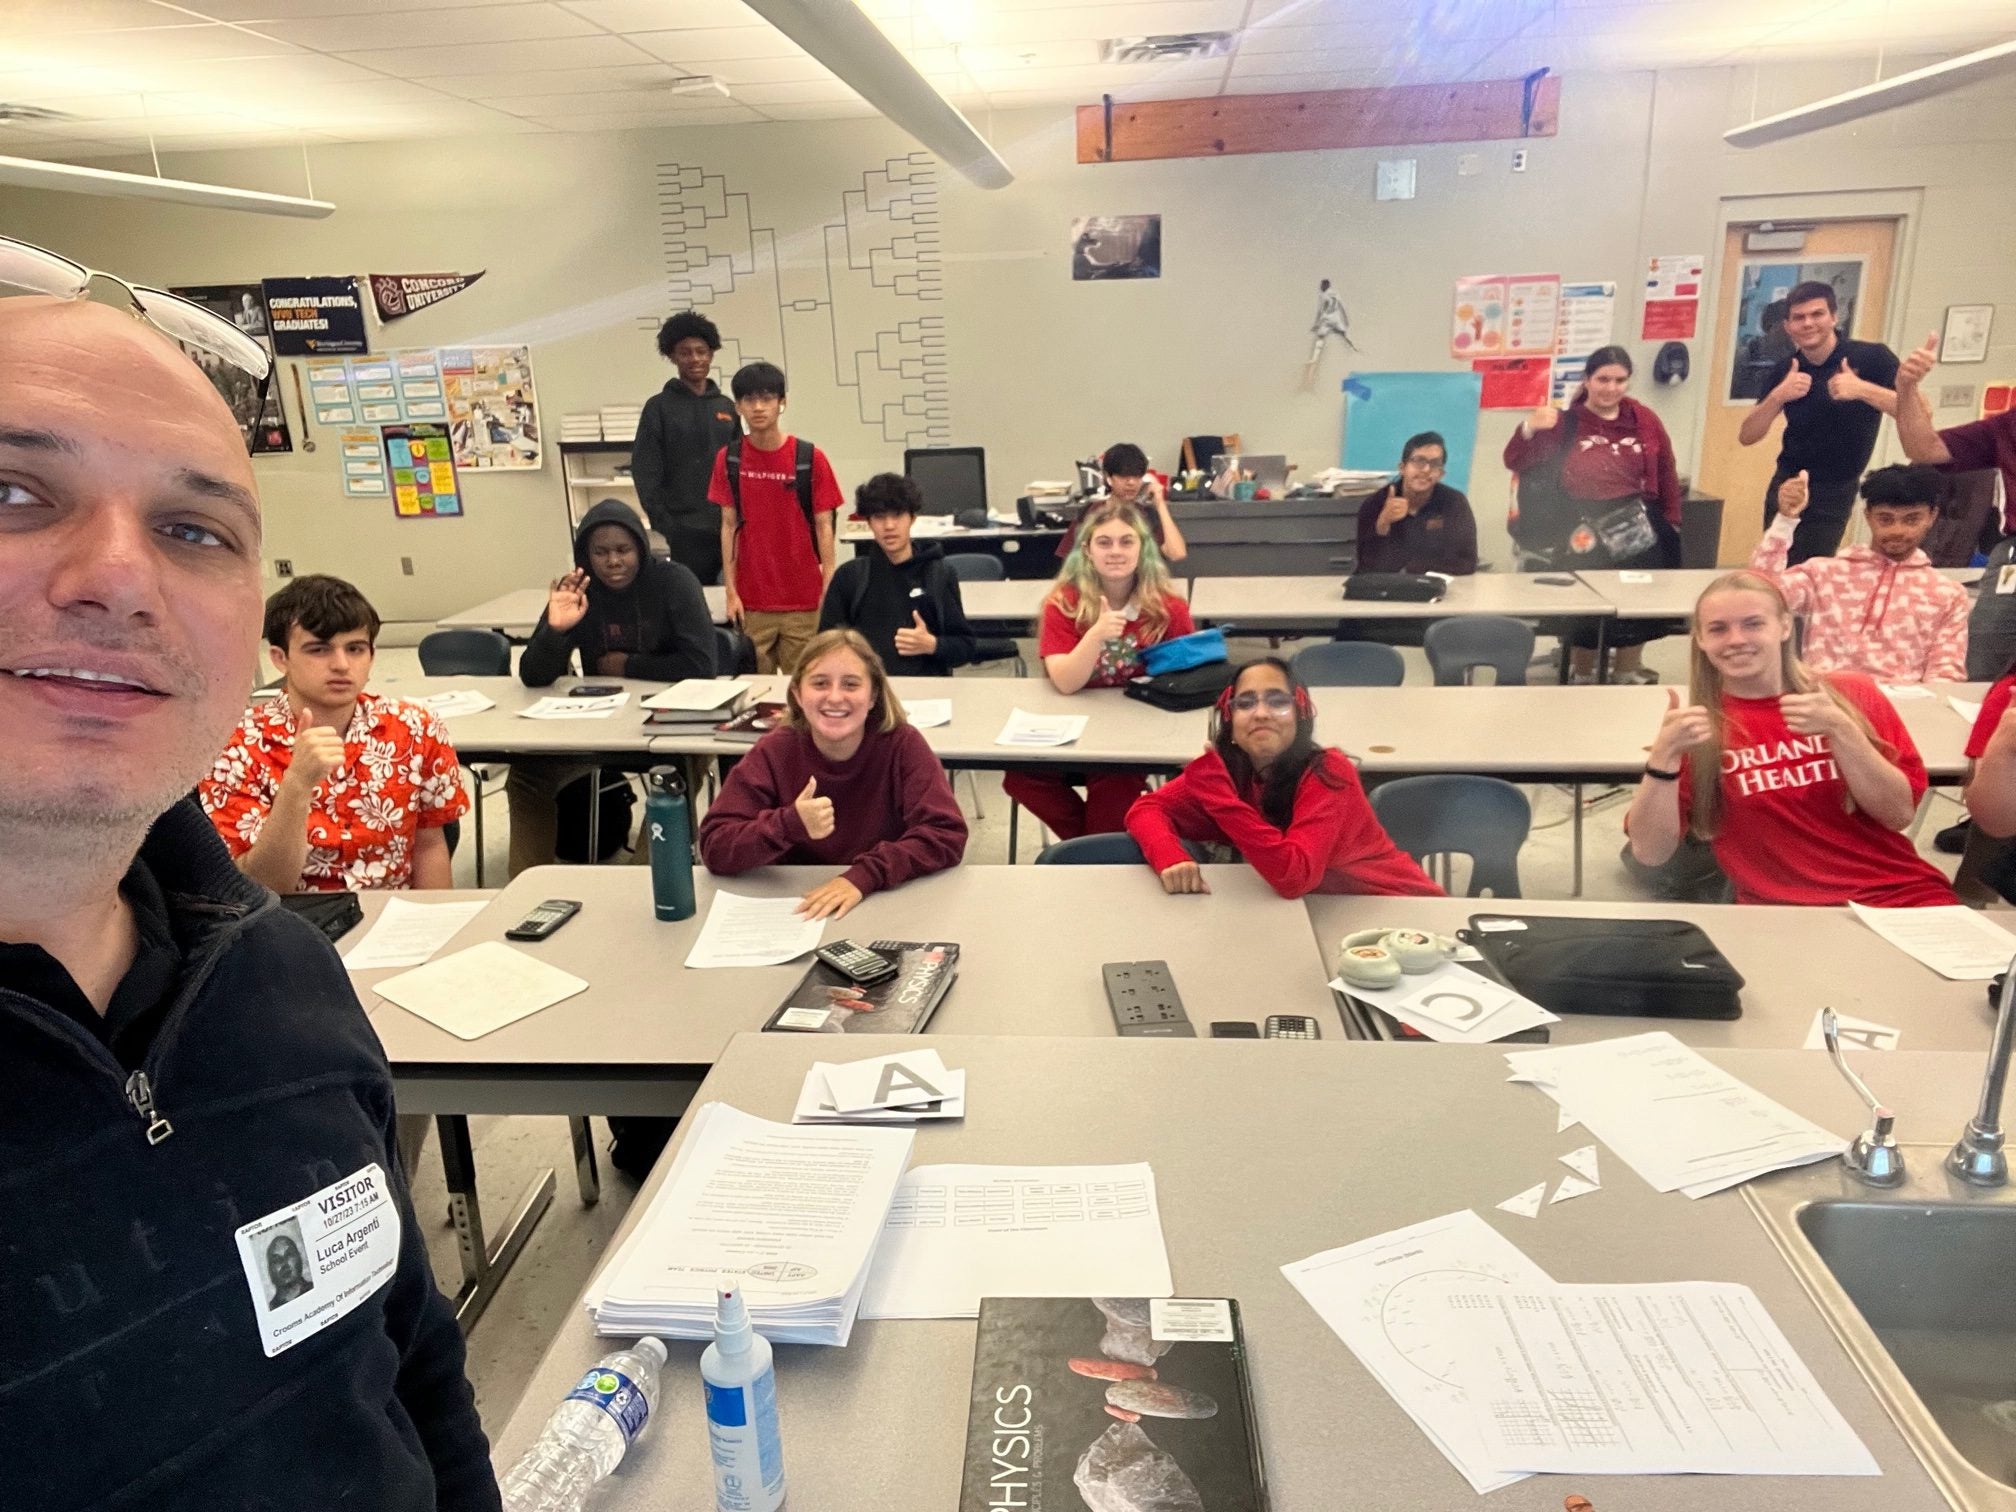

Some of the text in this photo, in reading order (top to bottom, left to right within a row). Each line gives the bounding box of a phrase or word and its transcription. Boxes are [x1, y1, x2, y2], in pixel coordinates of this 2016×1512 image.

[269, 296, 357, 309] CONGRATULATIONS,
[401, 278, 464, 293] CONCORD
[406, 283, 466, 311] UNIVERSITY
[273, 318, 329, 331] GRADUATES!
[295, 308, 318, 319] TECH
[1721, 734, 1833, 774] ORLAND
[898, 961, 939, 1004] PHYSICS
[873, 1062, 944, 1105] A
[318, 1177, 375, 1215] VISITOR
[323, 1191, 379, 1229] 10/27/23 7:15 AM
[316, 1216, 380, 1262] Luca Argenti
[320, 1241, 369, 1275] School Event
[304, 1299, 335, 1321] Academy
[989, 1384, 1032, 1512] HYSICS
